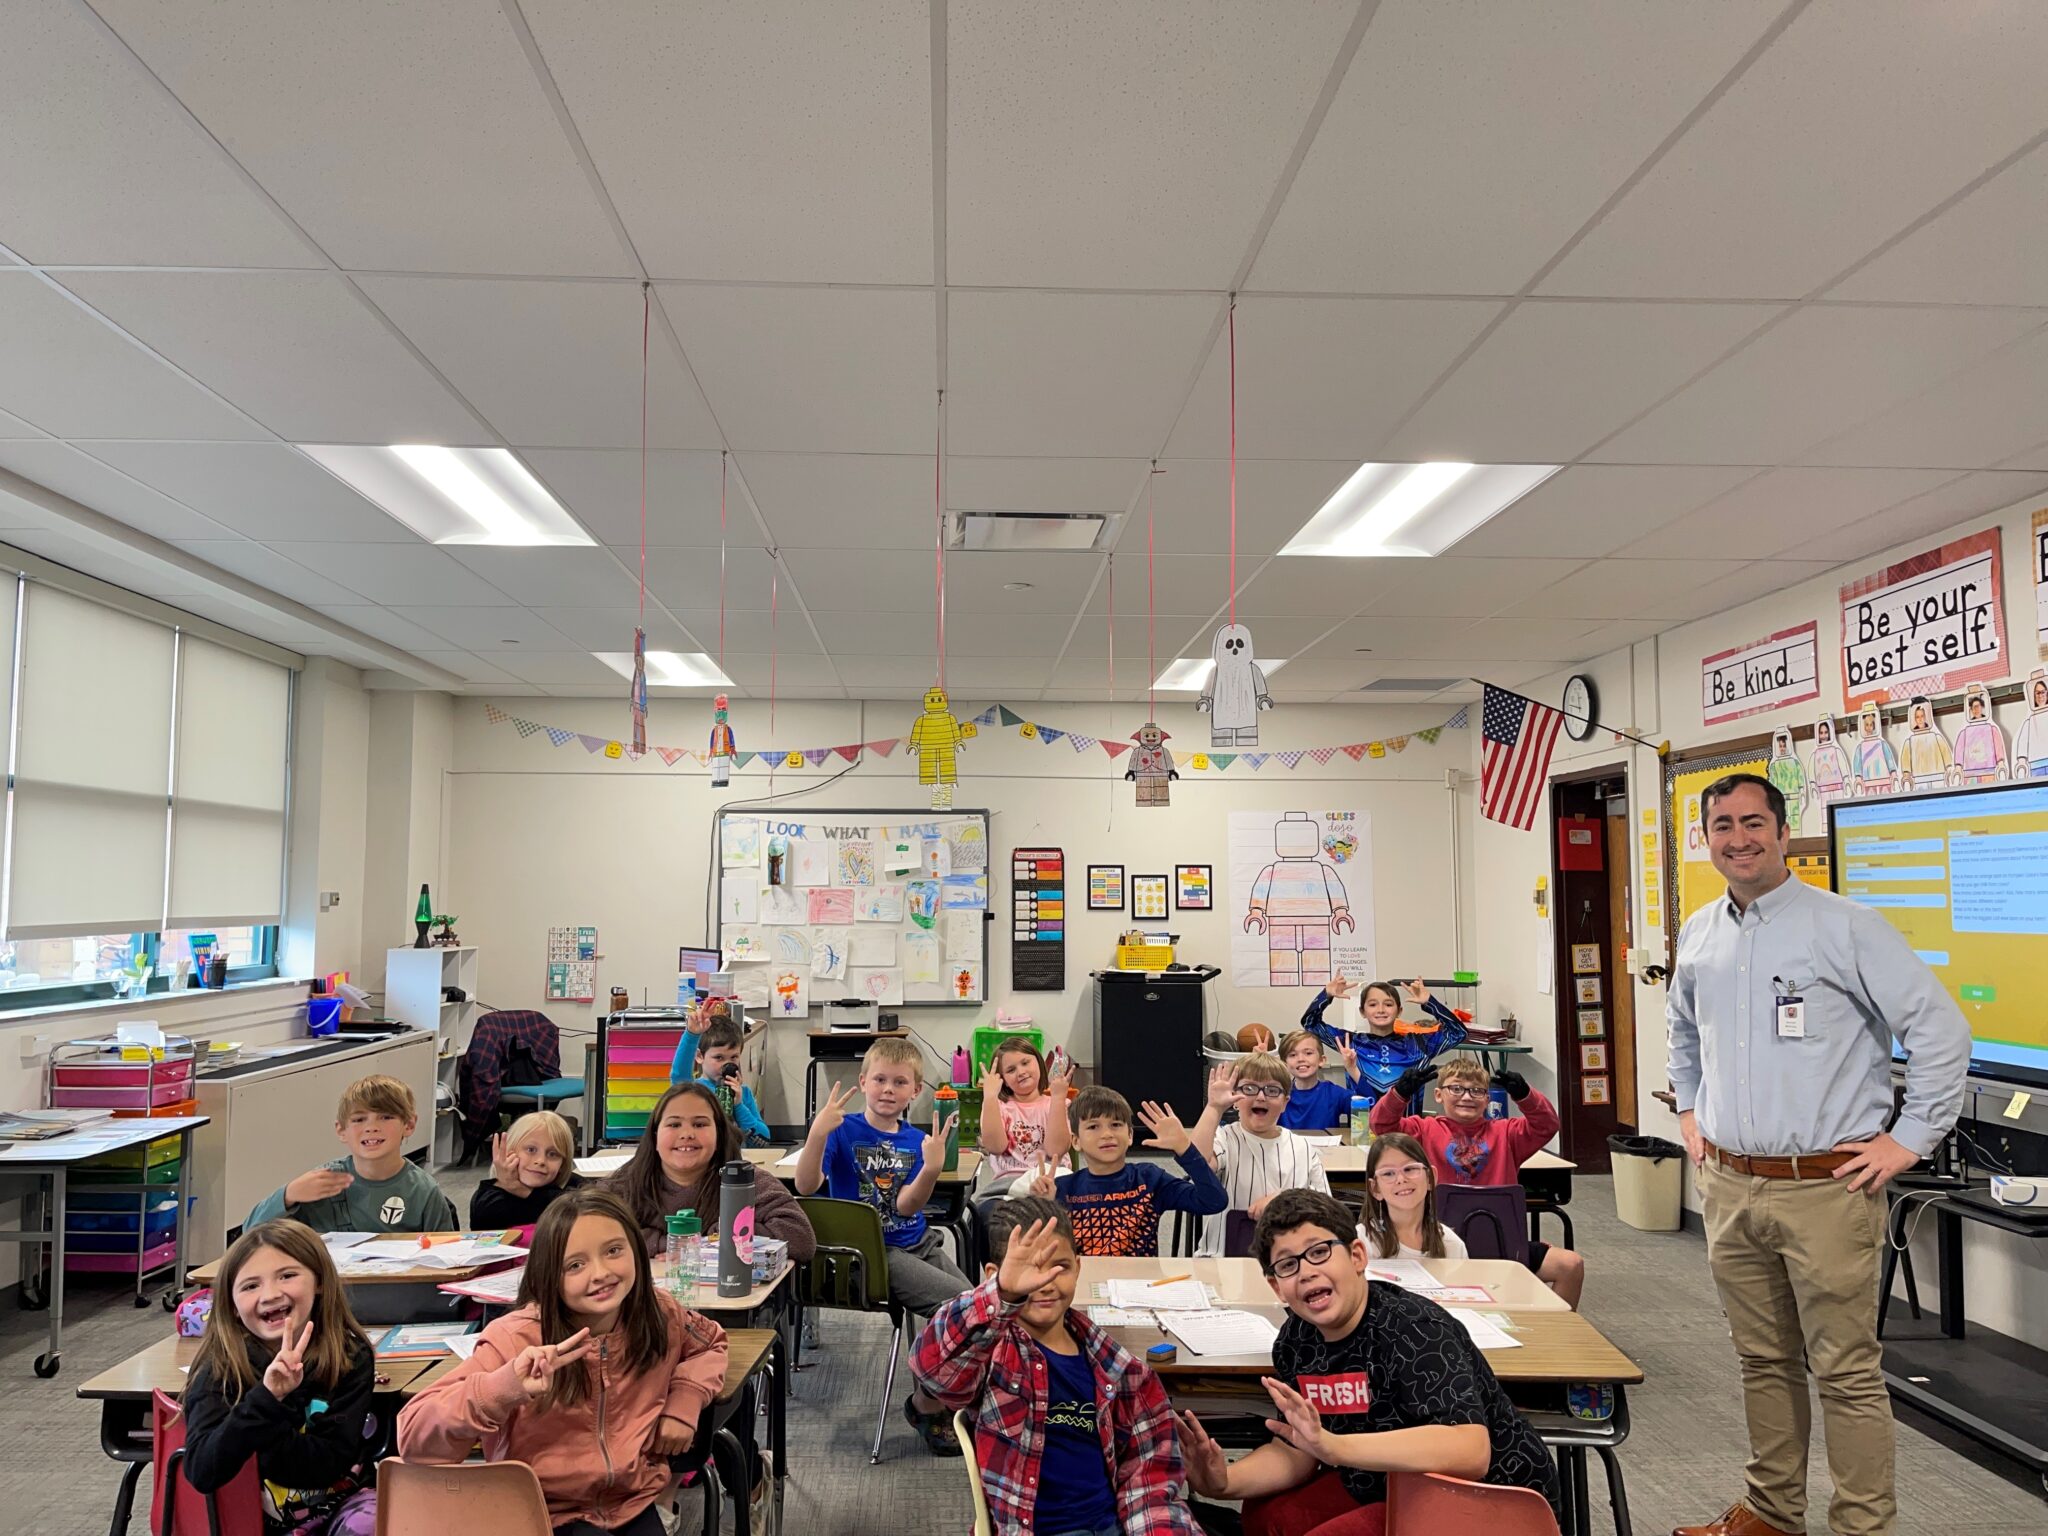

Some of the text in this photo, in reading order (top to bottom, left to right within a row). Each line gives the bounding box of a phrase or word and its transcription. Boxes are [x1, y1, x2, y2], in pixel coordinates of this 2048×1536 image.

[1859, 583, 1976, 643] Be your
[1847, 605, 1995, 686] best self.
[1713, 648, 1794, 704] Be kind.
[1326, 812, 1355, 821] CLASS
[767, 820, 809, 840] LOOK
[823, 826, 870, 840] WHAT
[1689, 826, 1709, 850] CR
[866, 1156, 903, 1170] NINJA
[1305, 1380, 1369, 1406] FRESH
